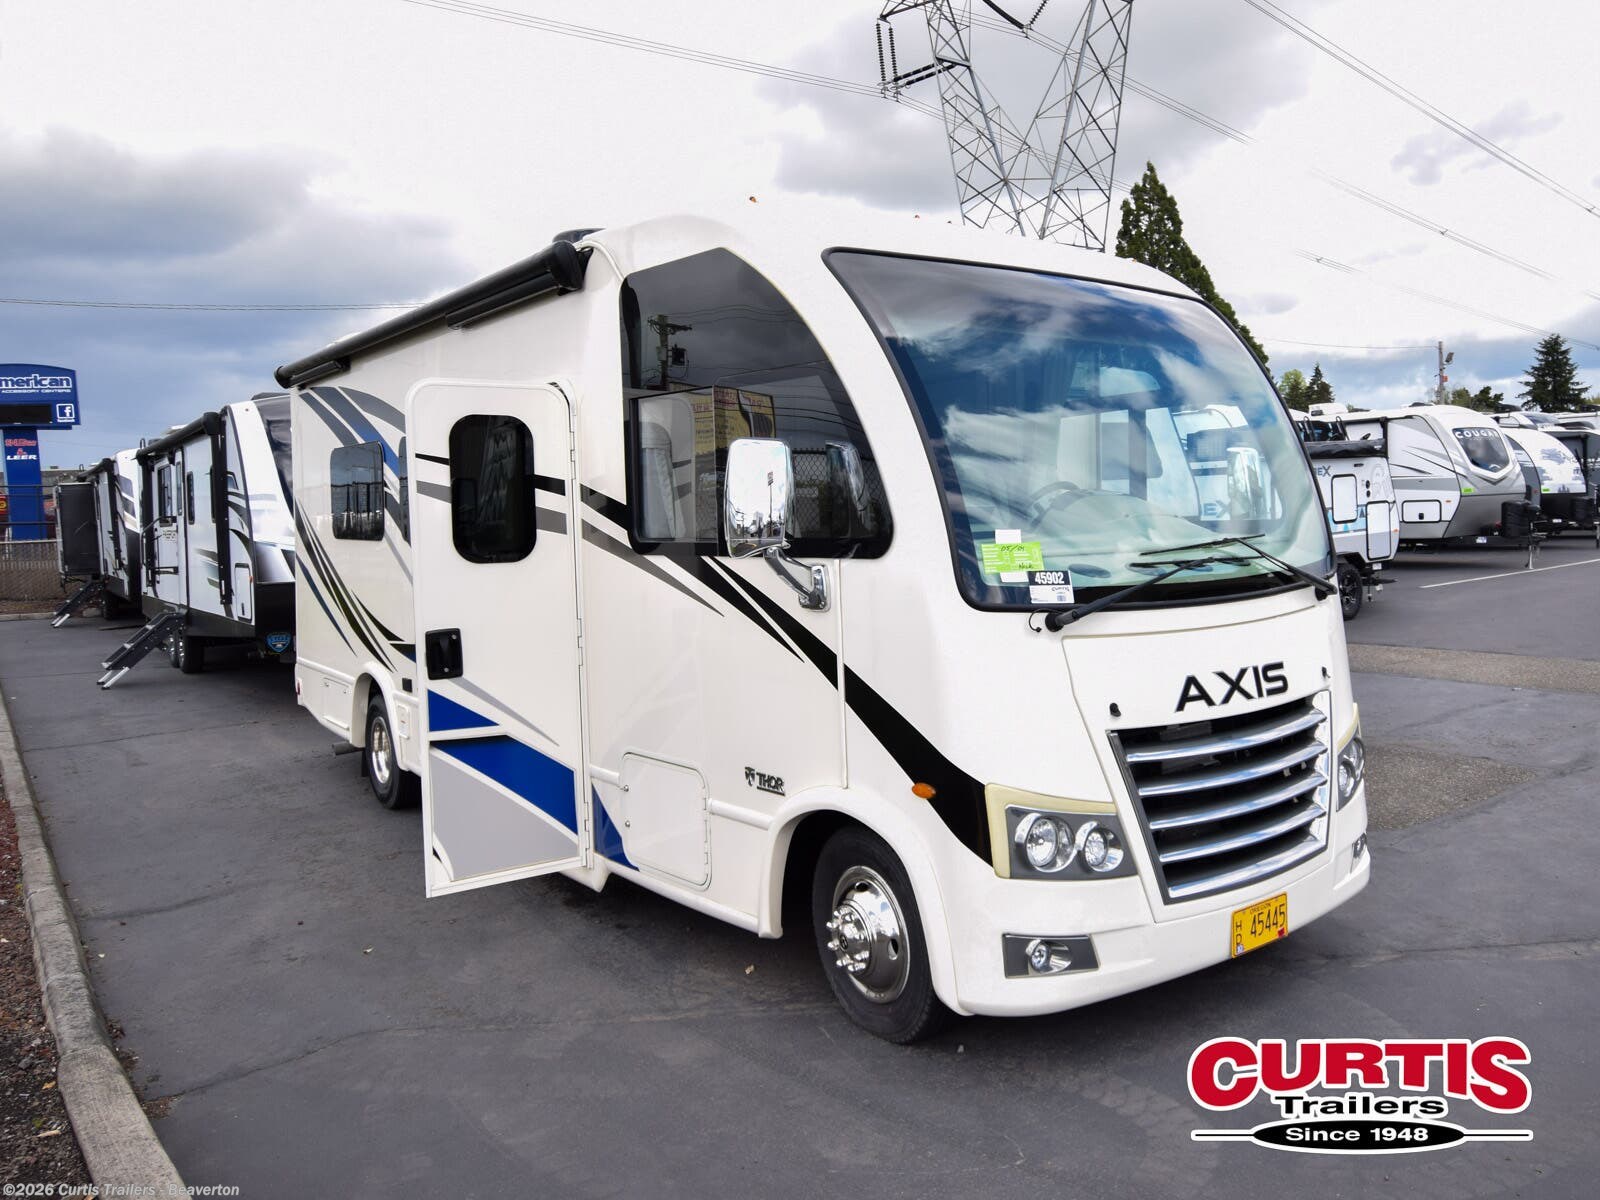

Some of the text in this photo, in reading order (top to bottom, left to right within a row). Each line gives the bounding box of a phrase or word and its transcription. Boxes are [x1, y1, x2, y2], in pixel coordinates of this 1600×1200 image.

[0, 373, 72, 389] merican
[1314, 465, 1331, 477] EX
[1034, 571, 1065, 585] 45902
[1174, 660, 1289, 713] AXIS
[756, 771, 785, 793] THOR
[1250, 902, 1286, 938] 45445
